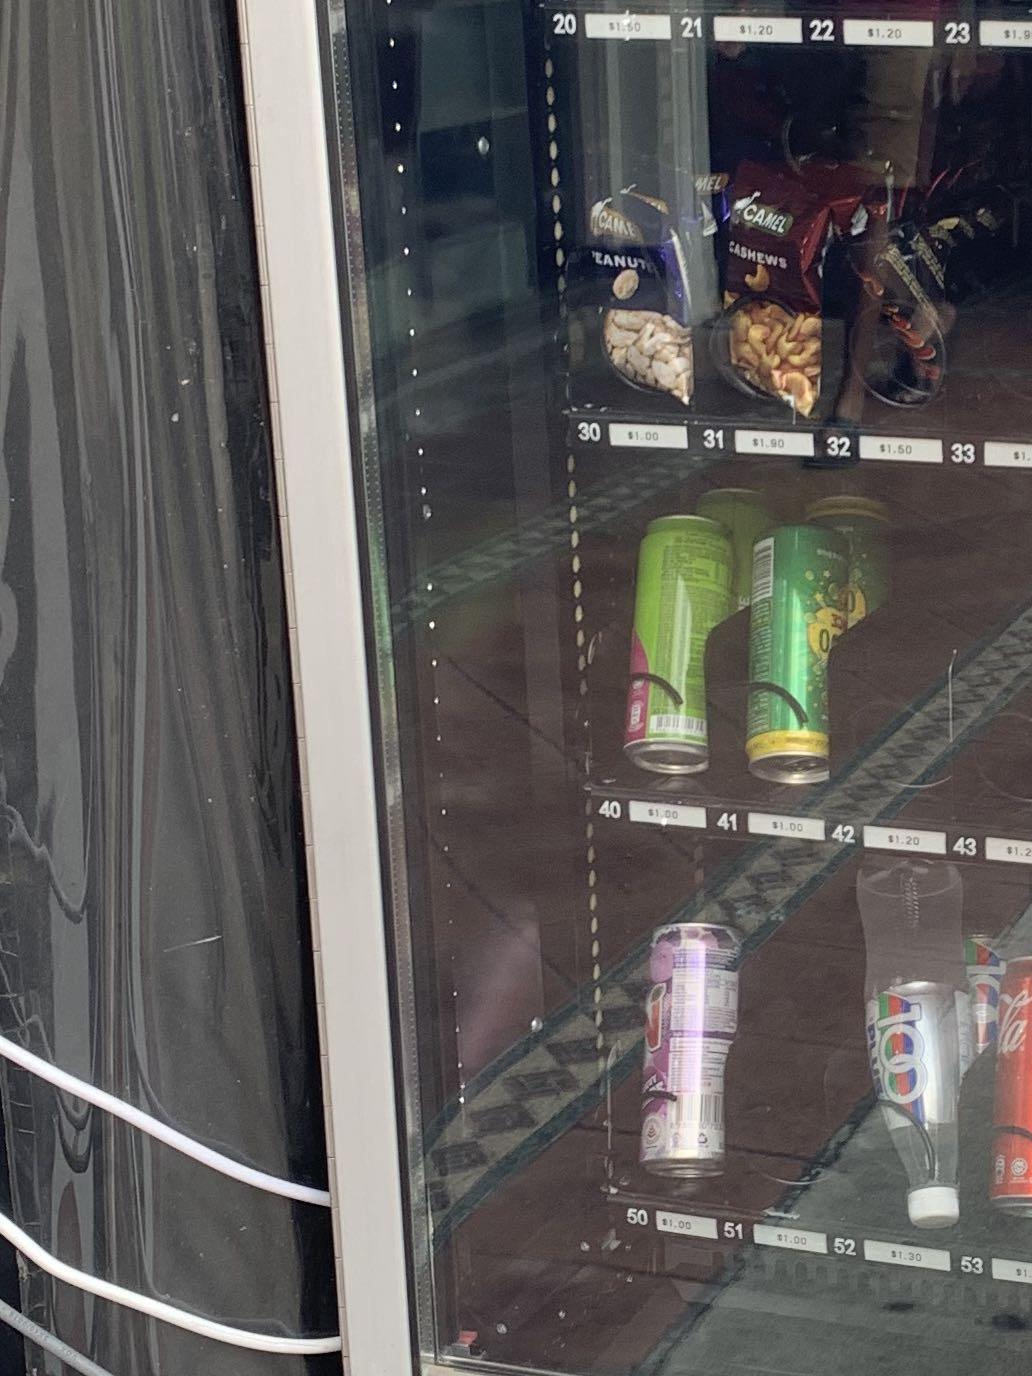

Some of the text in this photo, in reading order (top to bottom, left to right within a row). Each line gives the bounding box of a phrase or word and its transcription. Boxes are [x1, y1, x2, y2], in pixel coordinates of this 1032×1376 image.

[553, 14, 576, 35] 20
[681, 17, 702, 38] 21
[739, 24, 773, 36] $1.20
[809, 20, 835, 41] 22
[867, 28, 902, 40] $1.20
[945, 23, 970, 45] 23
[743, 205, 785, 234] CAMEL
[729, 240, 787, 270] CASHEWS
[577, 422, 600, 442] 30
[628, 430, 659, 442] $1.00
[703, 429, 724, 449] 31
[826, 436, 851, 456] 32
[879, 444, 912, 455] $1.50
[950, 443, 975, 463] 33
[598, 800, 621, 819] 40
[648, 808, 679, 820] $1.00
[716, 812, 738, 832] 41
[772, 821, 804, 833] $1.00
[831, 825, 855, 844] 42
[887, 834, 920, 846] $1.20
[952, 837, 977, 856] 43
[626, 1207, 648, 1226] 50
[662, 1217, 692, 1230] $1.00
[723, 1222, 743, 1240] 51
[776, 1233, 807, 1246] $1.00
[833, 1237, 857, 1256] 52
[891, 1250, 922, 1263] $1.30
[960, 1256, 984, 1274] 53
